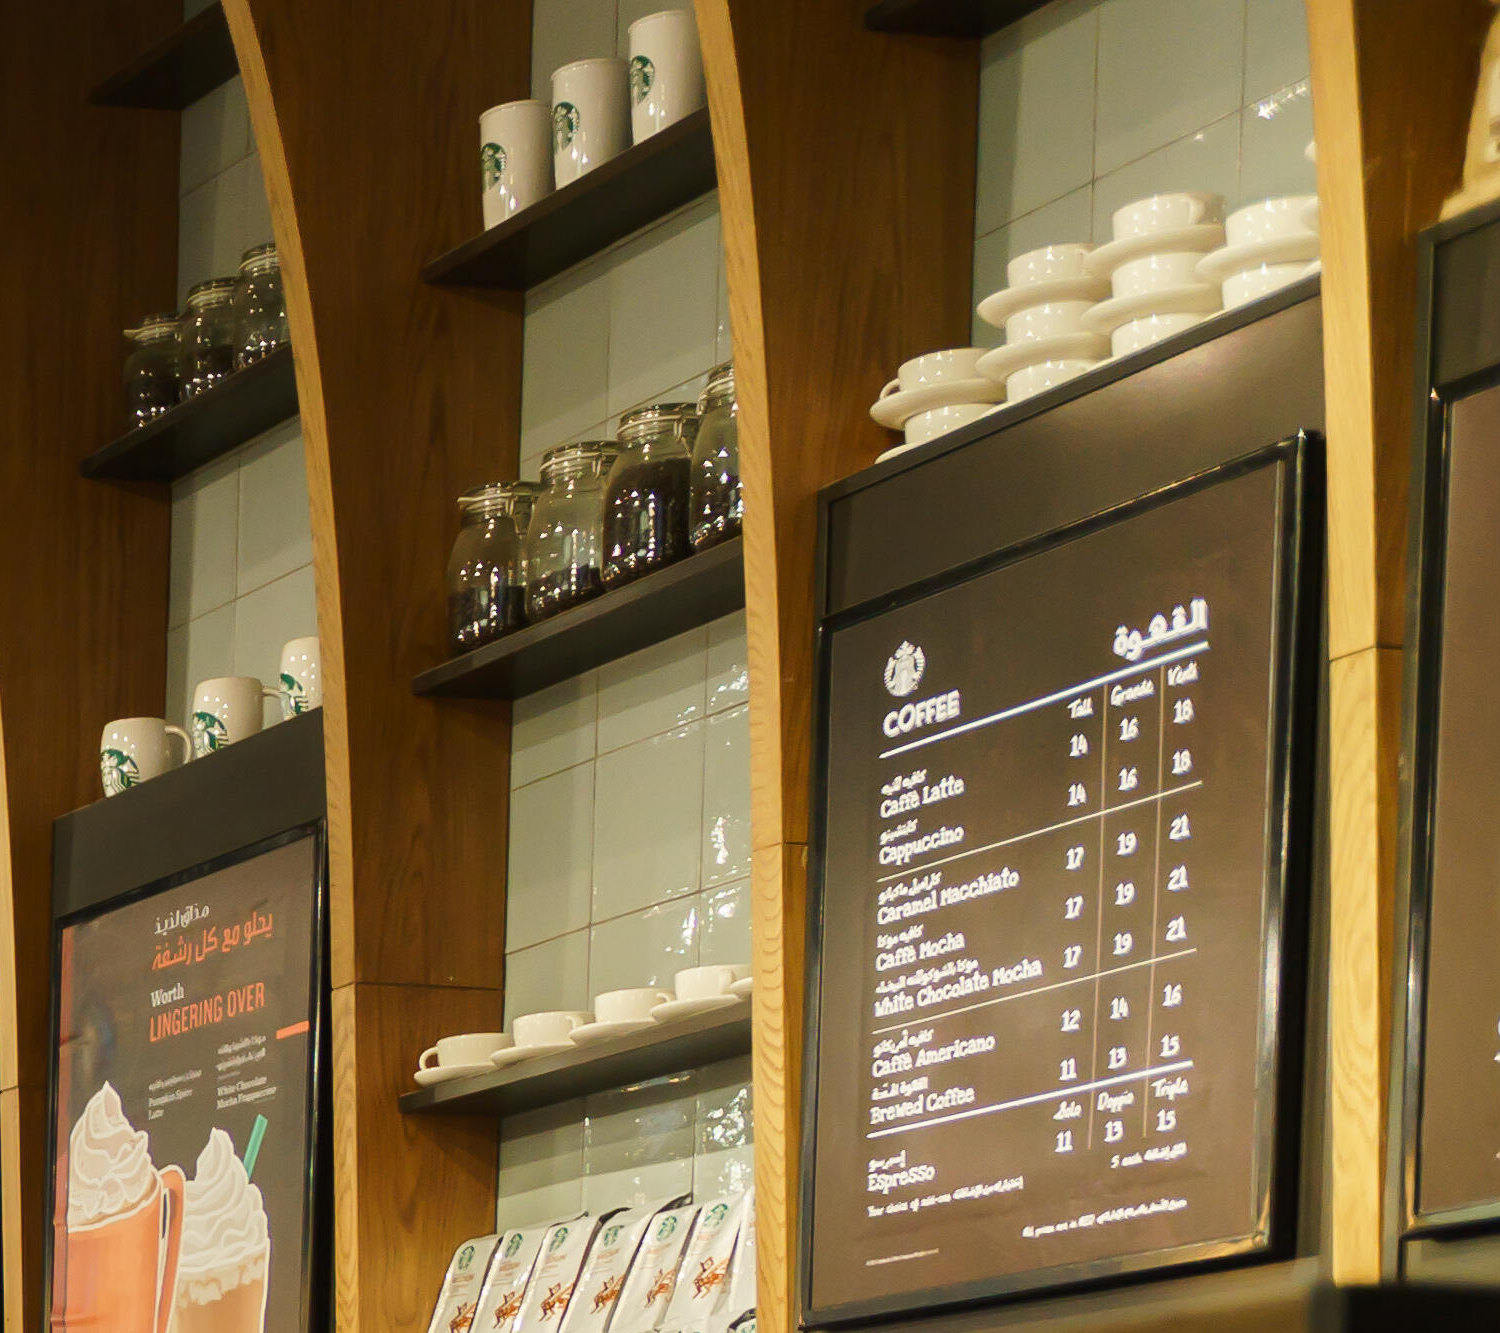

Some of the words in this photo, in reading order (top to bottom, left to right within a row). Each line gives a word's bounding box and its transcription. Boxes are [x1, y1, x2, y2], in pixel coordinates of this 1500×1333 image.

[1113, 598, 1208, 661] القهوة
[883, 689, 961, 738] COFFEE
[922, 774, 965, 805] Latte
[1069, 733, 1090, 758] 14
[1119, 716, 1140, 741] 16
[1173, 698, 1195, 724] 18
[879, 826, 965, 865] Cappuccino
[1067, 783, 1088, 807] 14
[1118, 767, 1139, 791] 16
[1172, 749, 1193, 775] 18
[877, 889, 939, 925] Caramel
[940, 866, 1020, 907] Macchiato
[1065, 846, 1085, 871] 17
[1117, 832, 1138, 856] 19
[1169, 813, 1192, 840] 21
[196, 926, 218, 962] كل
[221, 925, 240, 952] مع
[919, 932, 965, 960] Mocha
[1064, 895, 1084, 920] 17
[1115, 882, 1136, 906] 19
[1167, 865, 1189, 891] 21
[150, 982, 185, 1008] Worth
[874, 991, 914, 1017] White
[916, 971, 989, 1007] Chocolate
[991, 958, 1043, 987] Mocha
[1063, 945, 1083, 969] 17
[1113, 932, 1133, 955] 19
[1165, 915, 1187, 941] 21
[149, 995, 223, 1042] LINGERING
[227, 982, 265, 1018] OVER
[914, 1035, 996, 1067] Americano
[1061, 1009, 1081, 1032] 12
[1110, 997, 1130, 1020] 14
[1162, 984, 1182, 1007] 16
[870, 1094, 924, 1124] Brewed
[926, 1086, 975, 1112] Coffee
[1059, 1057, 1078, 1081] 11
[1108, 1046, 1128, 1069] 13
[1160, 1034, 1180, 1057] 15
[867, 1165, 936, 1195] Espresso
[1054, 1130, 1074, 1153] 11
[1104, 1120, 1123, 1142] 13
[1156, 1109, 1176, 1132] 15
